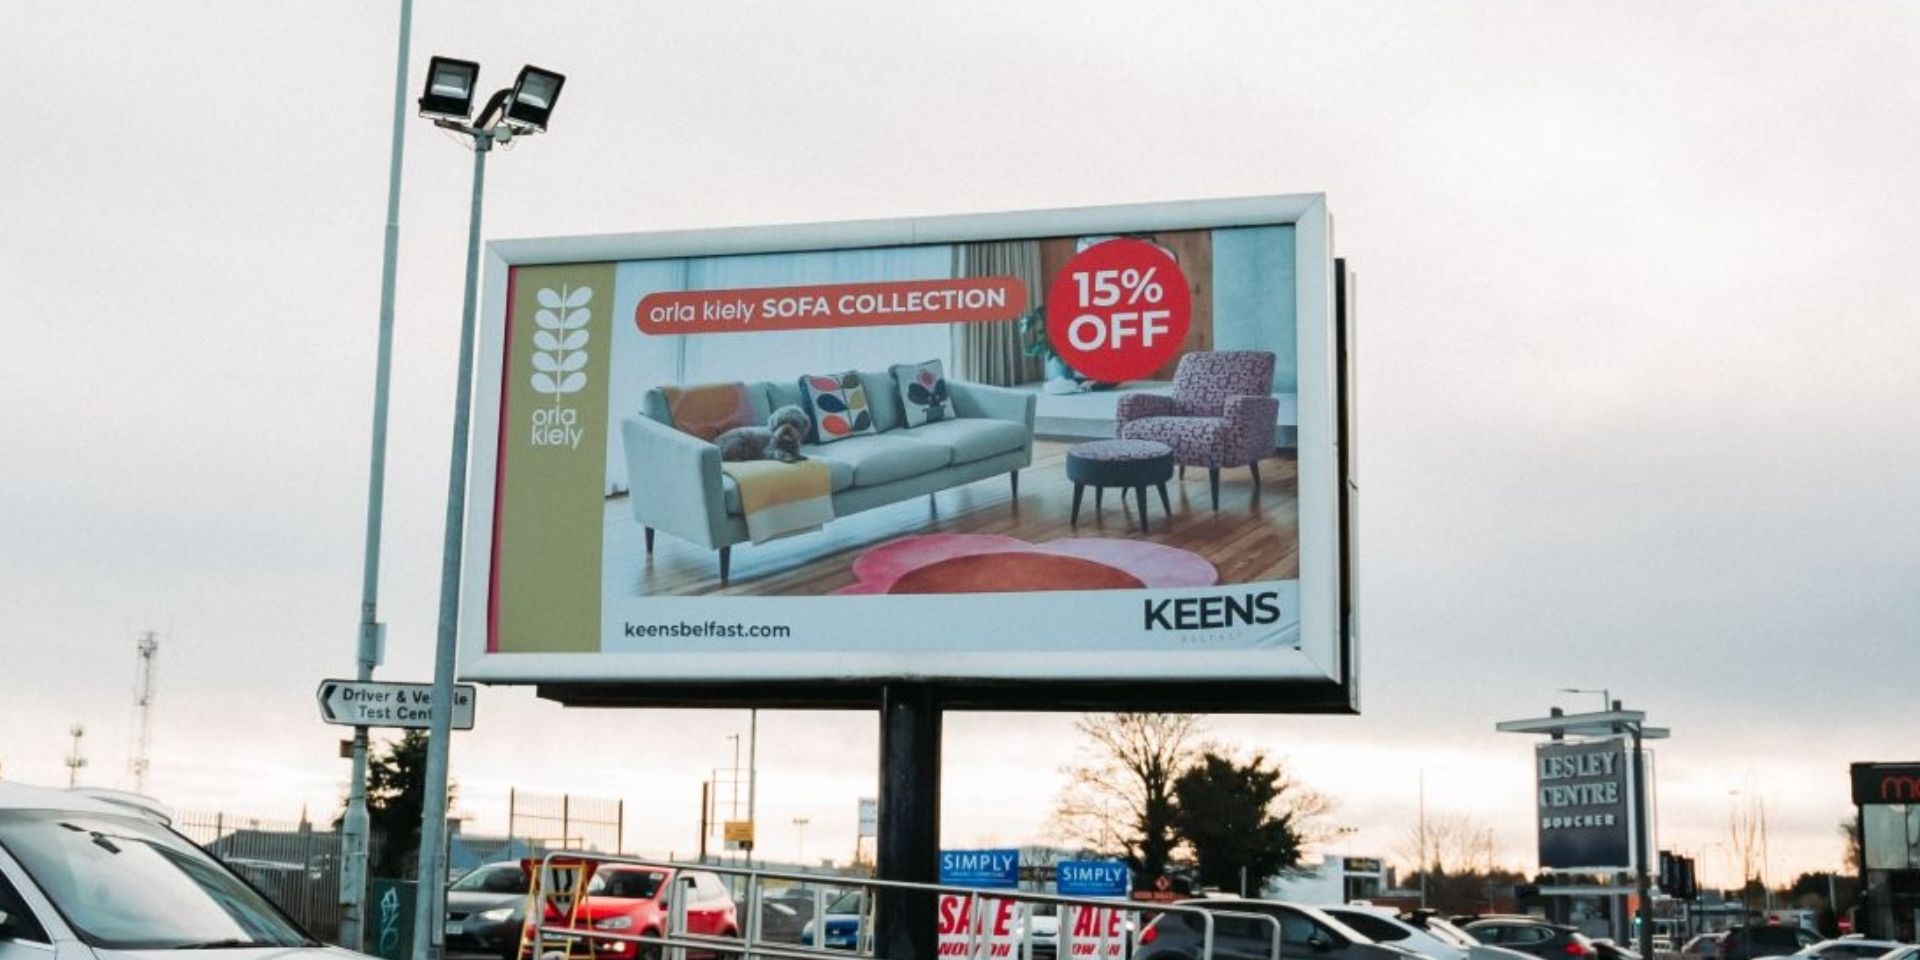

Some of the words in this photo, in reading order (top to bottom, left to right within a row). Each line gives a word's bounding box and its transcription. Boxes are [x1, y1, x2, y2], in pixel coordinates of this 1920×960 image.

[1071, 266, 1164, 309] 15%
[650, 302, 696, 323] orla
[702, 300, 755, 323] kiely
[762, 297, 831, 318] SOFA
[837, 287, 1006, 315] COLLECTION
[1067, 309, 1171, 352] OFF
[532, 406, 577, 427] orla
[530, 423, 584, 450] kiely
[1144, 591, 1281, 631] KEENS
[624, 621, 791, 639] keensbelfast.com
[342, 687, 389, 702] Driver
[396, 690, 406, 703] &
[412, 690, 468, 706] Vele
[359, 705, 391, 719] Test
[396, 706, 432, 720] Cent
[1541, 751, 1618, 780] LESLEY
[1541, 781, 1620, 808] CENTRE
[943, 853, 1014, 872] SIMPLY
[1062, 866, 1122, 882] SIMPLY
